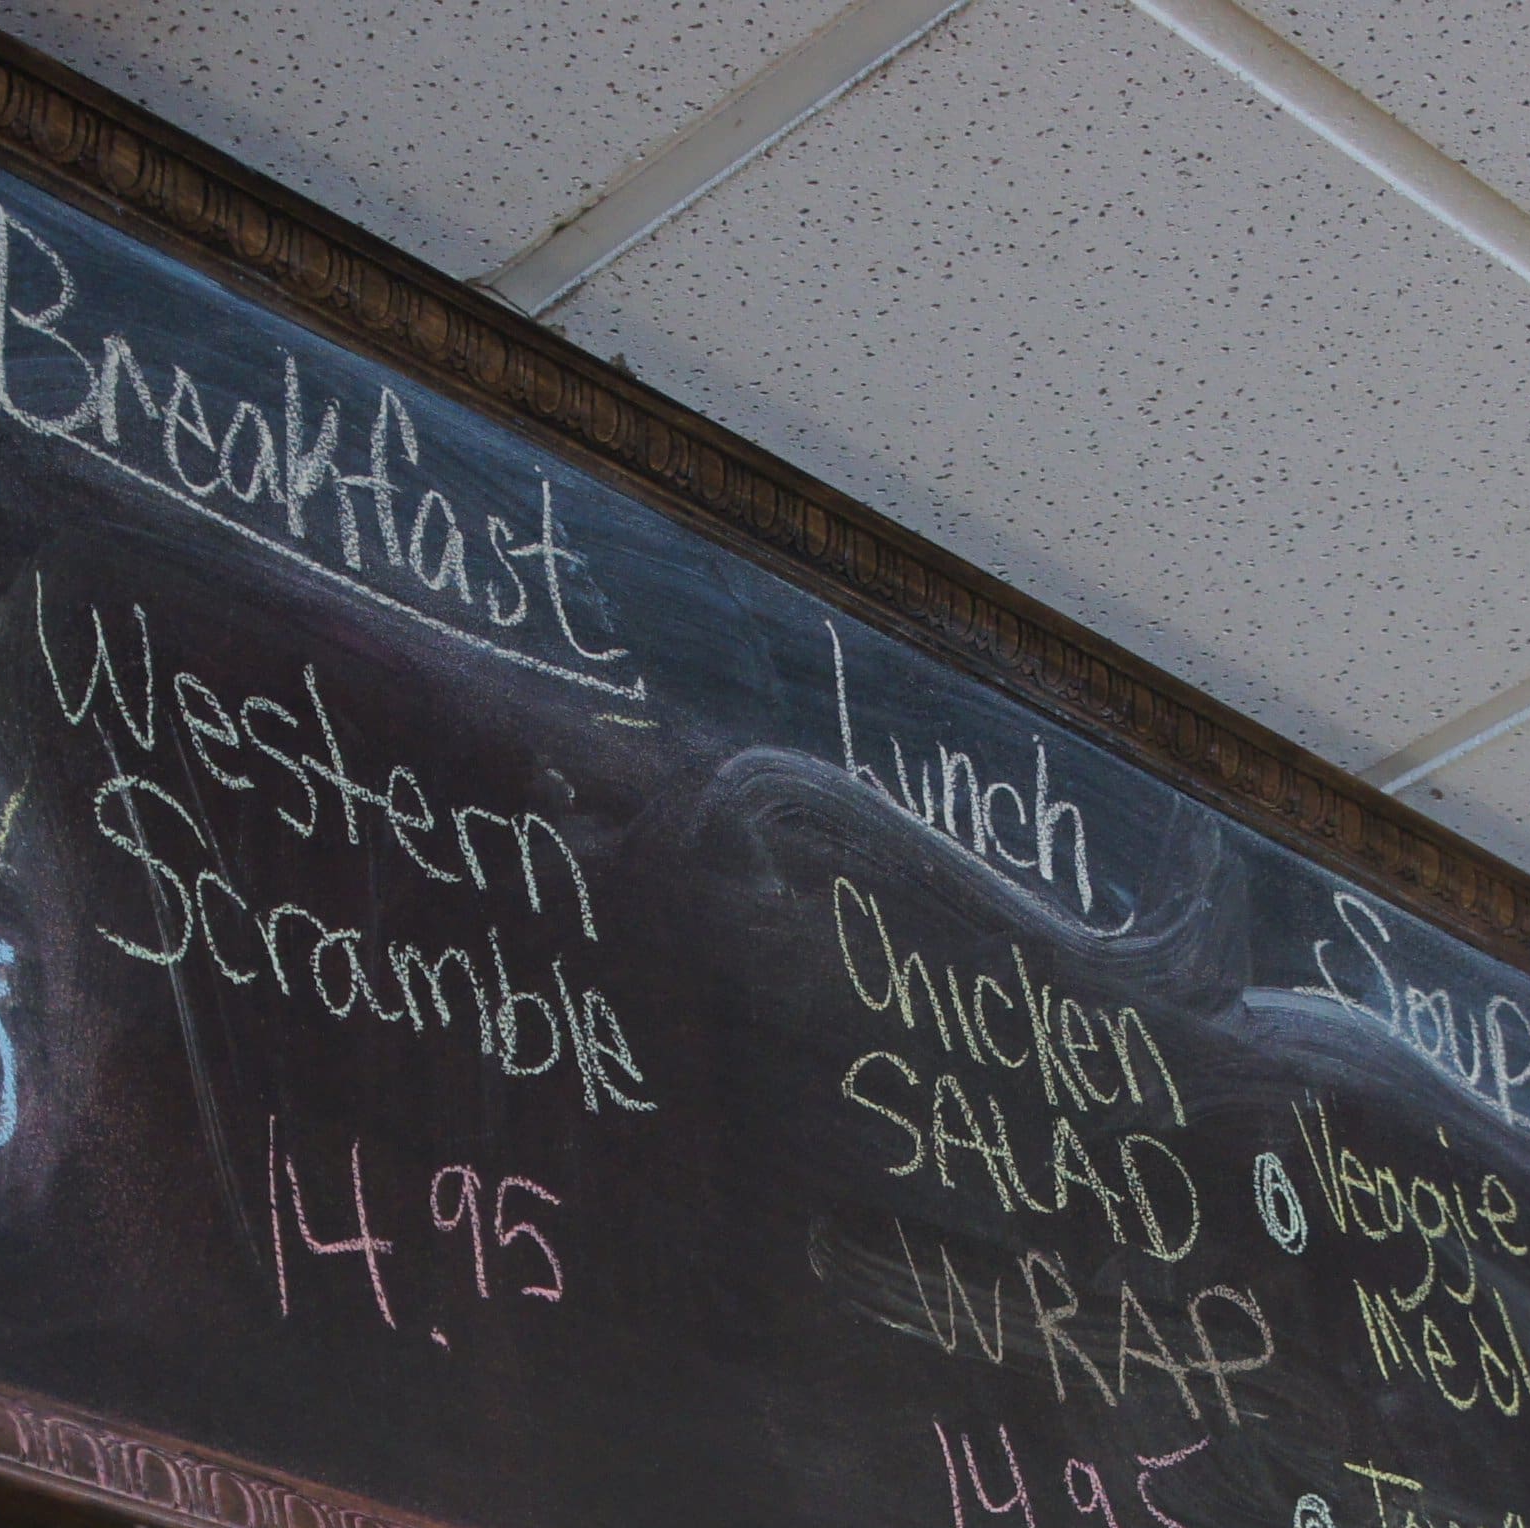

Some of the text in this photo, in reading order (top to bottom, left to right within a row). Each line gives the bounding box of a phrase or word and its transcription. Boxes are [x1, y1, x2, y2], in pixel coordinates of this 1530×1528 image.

[36, 569, 598, 942] Western
[824, 619, 1109, 920] Lunch
[93, 774, 658, 1114] Scramble
[833, 875, 1187, 1127] Chicken
[841, 1050, 1201, 1264] SALAD
[1292, 1097, 1529, 1312] Veggie
[895, 1217, 1275, 1428] WRAP
